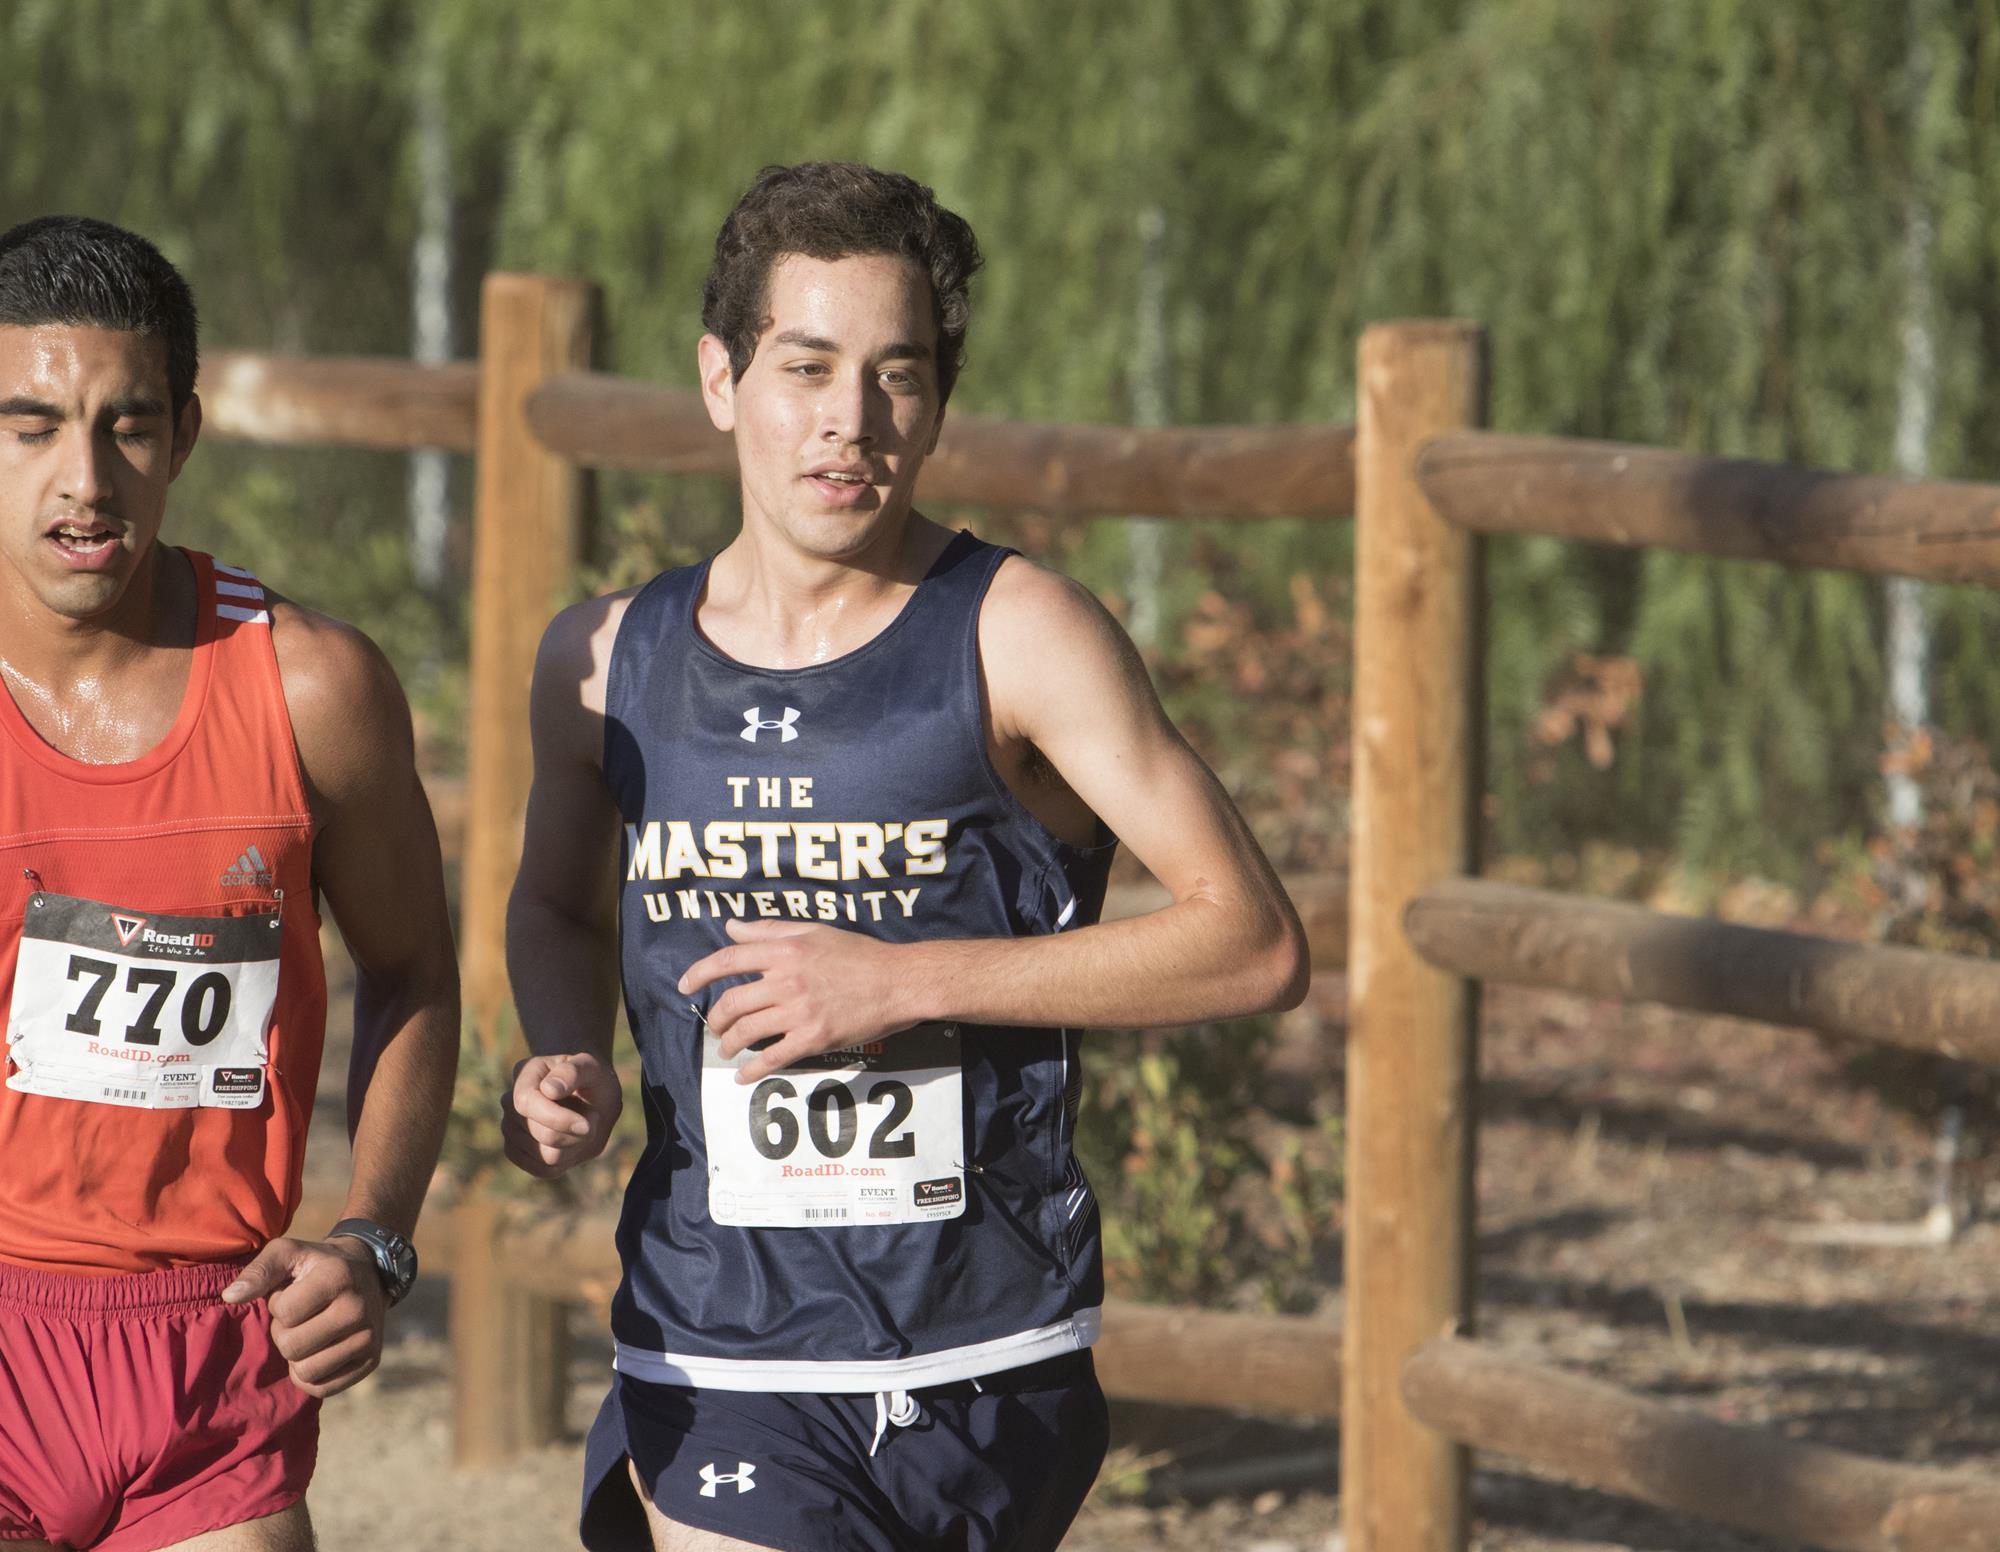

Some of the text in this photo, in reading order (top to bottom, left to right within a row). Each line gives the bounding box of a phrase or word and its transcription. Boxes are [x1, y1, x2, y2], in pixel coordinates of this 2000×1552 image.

[727, 776, 813, 808] THE
[624, 819, 948, 881] MASTER'S
[643, 887, 921, 923] UNIVERSITY
[143, 928, 214, 948] RoadID
[65, 954, 231, 1046] 770
[88, 1041, 191, 1064] RoadID.com
[163, 1073, 197, 1081] EVENT
[749, 1077, 916, 1160] 602
[782, 1164, 887, 1177] RoadID.com
[860, 1188, 896, 1196] EVENT
